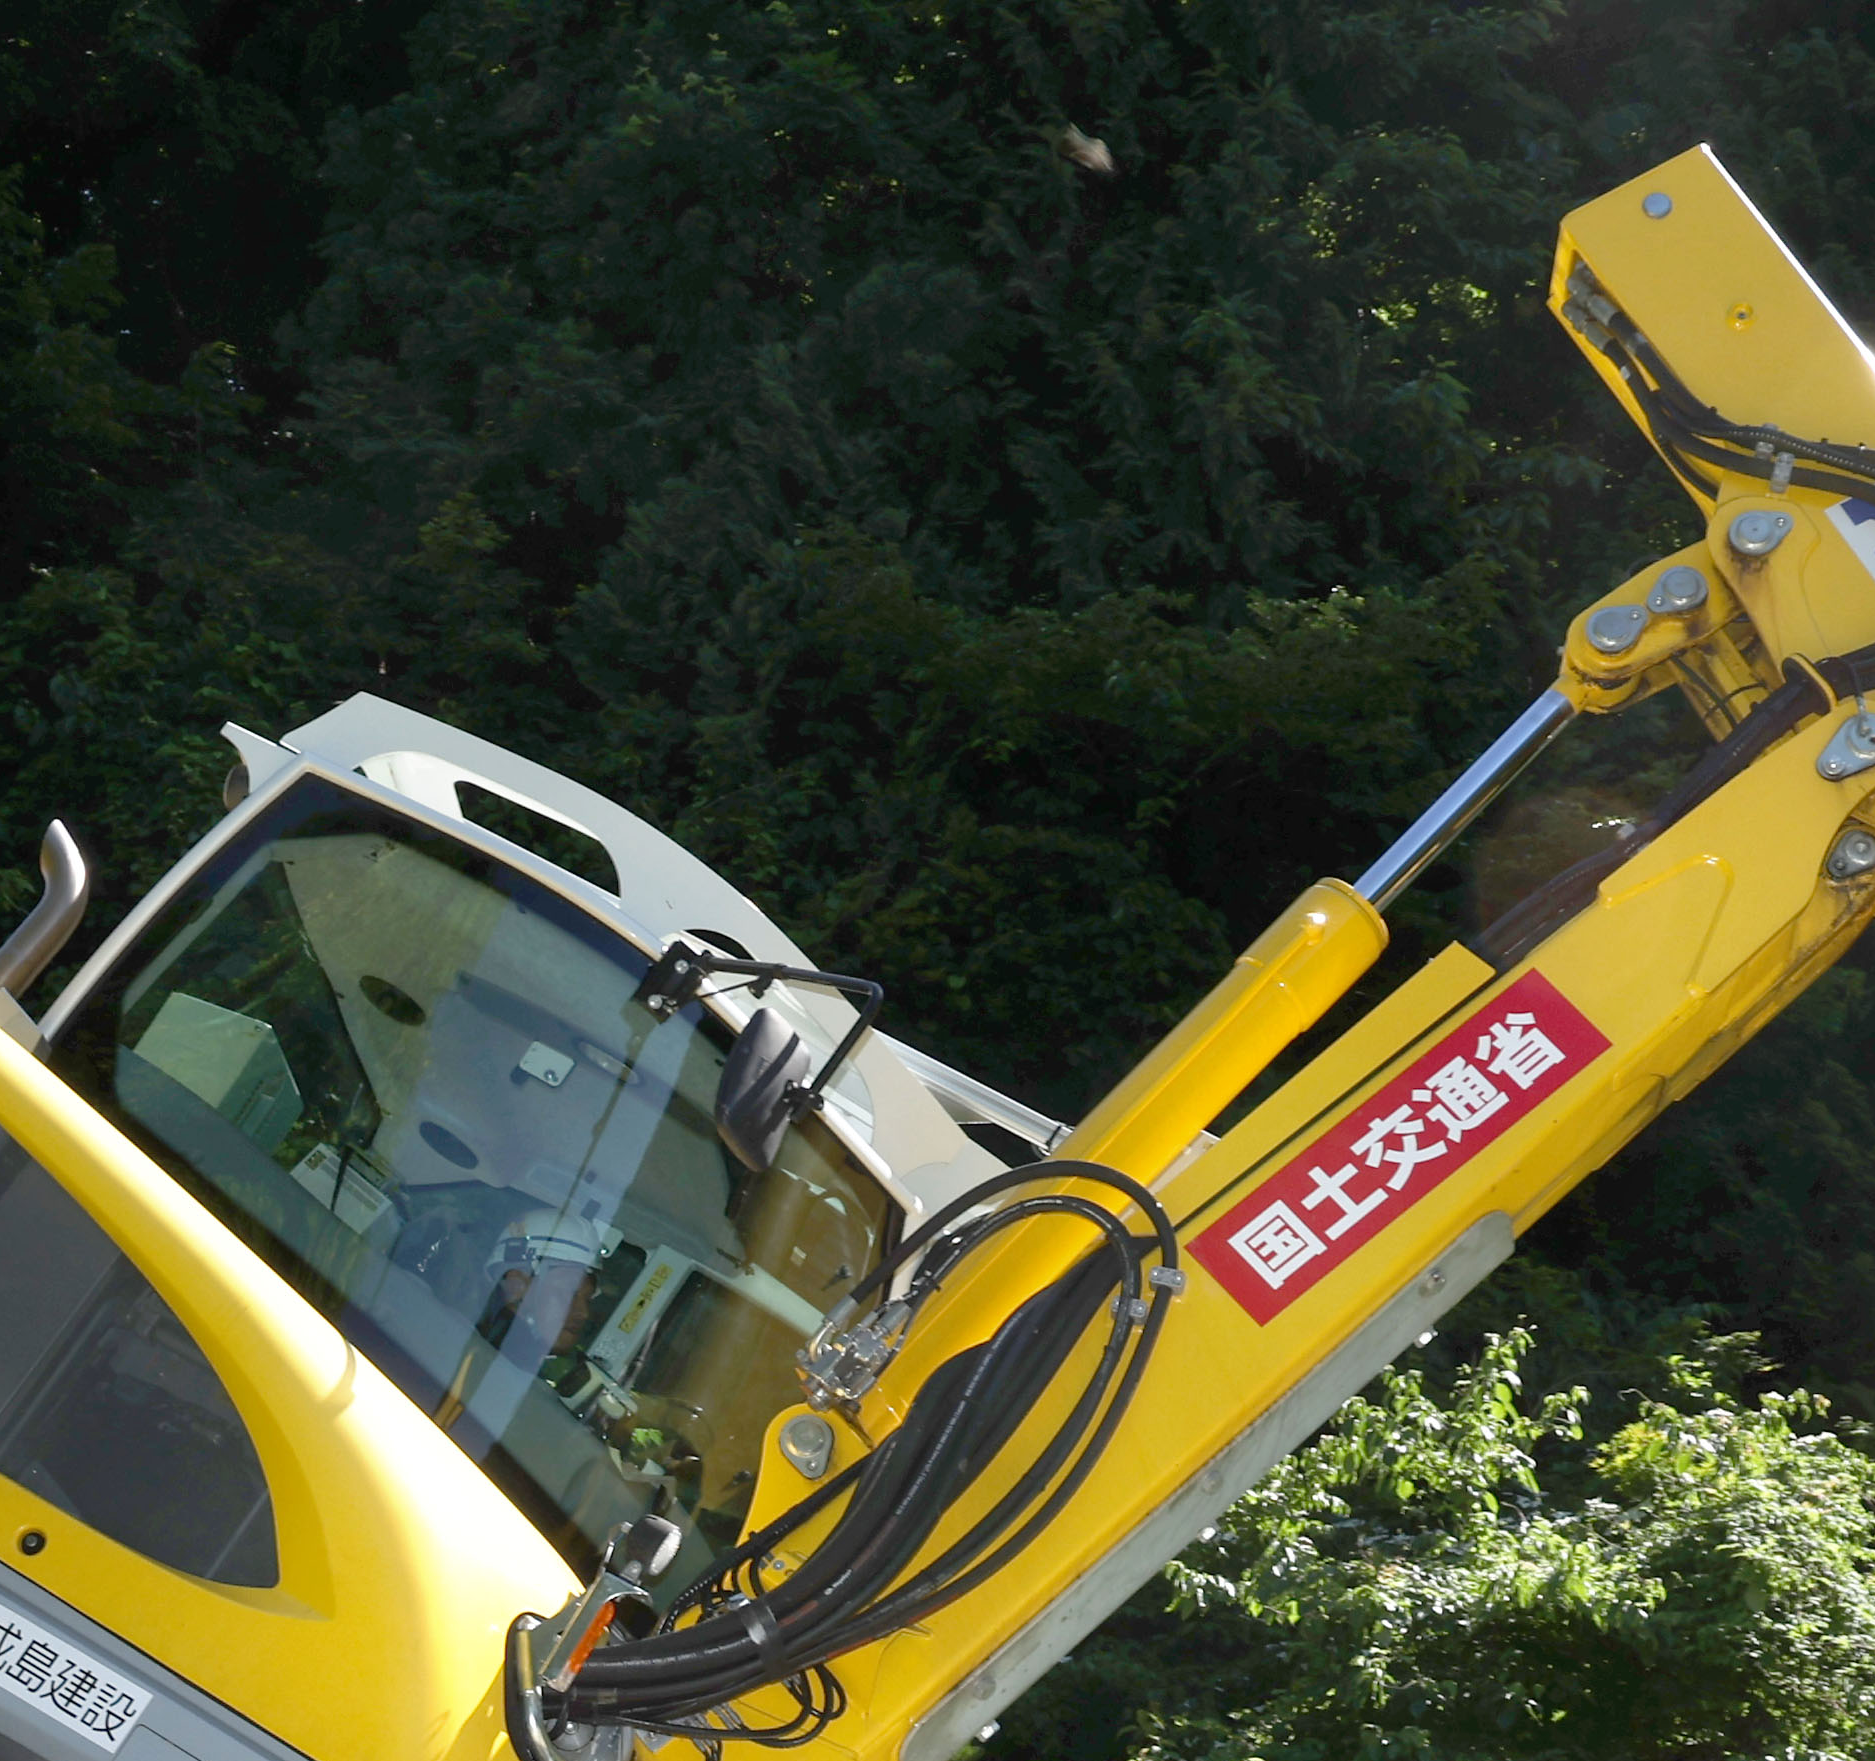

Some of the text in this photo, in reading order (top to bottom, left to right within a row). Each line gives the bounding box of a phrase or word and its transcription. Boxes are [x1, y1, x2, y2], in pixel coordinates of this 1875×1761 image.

[1227, 1011, 1566, 1290] 国土交通省
